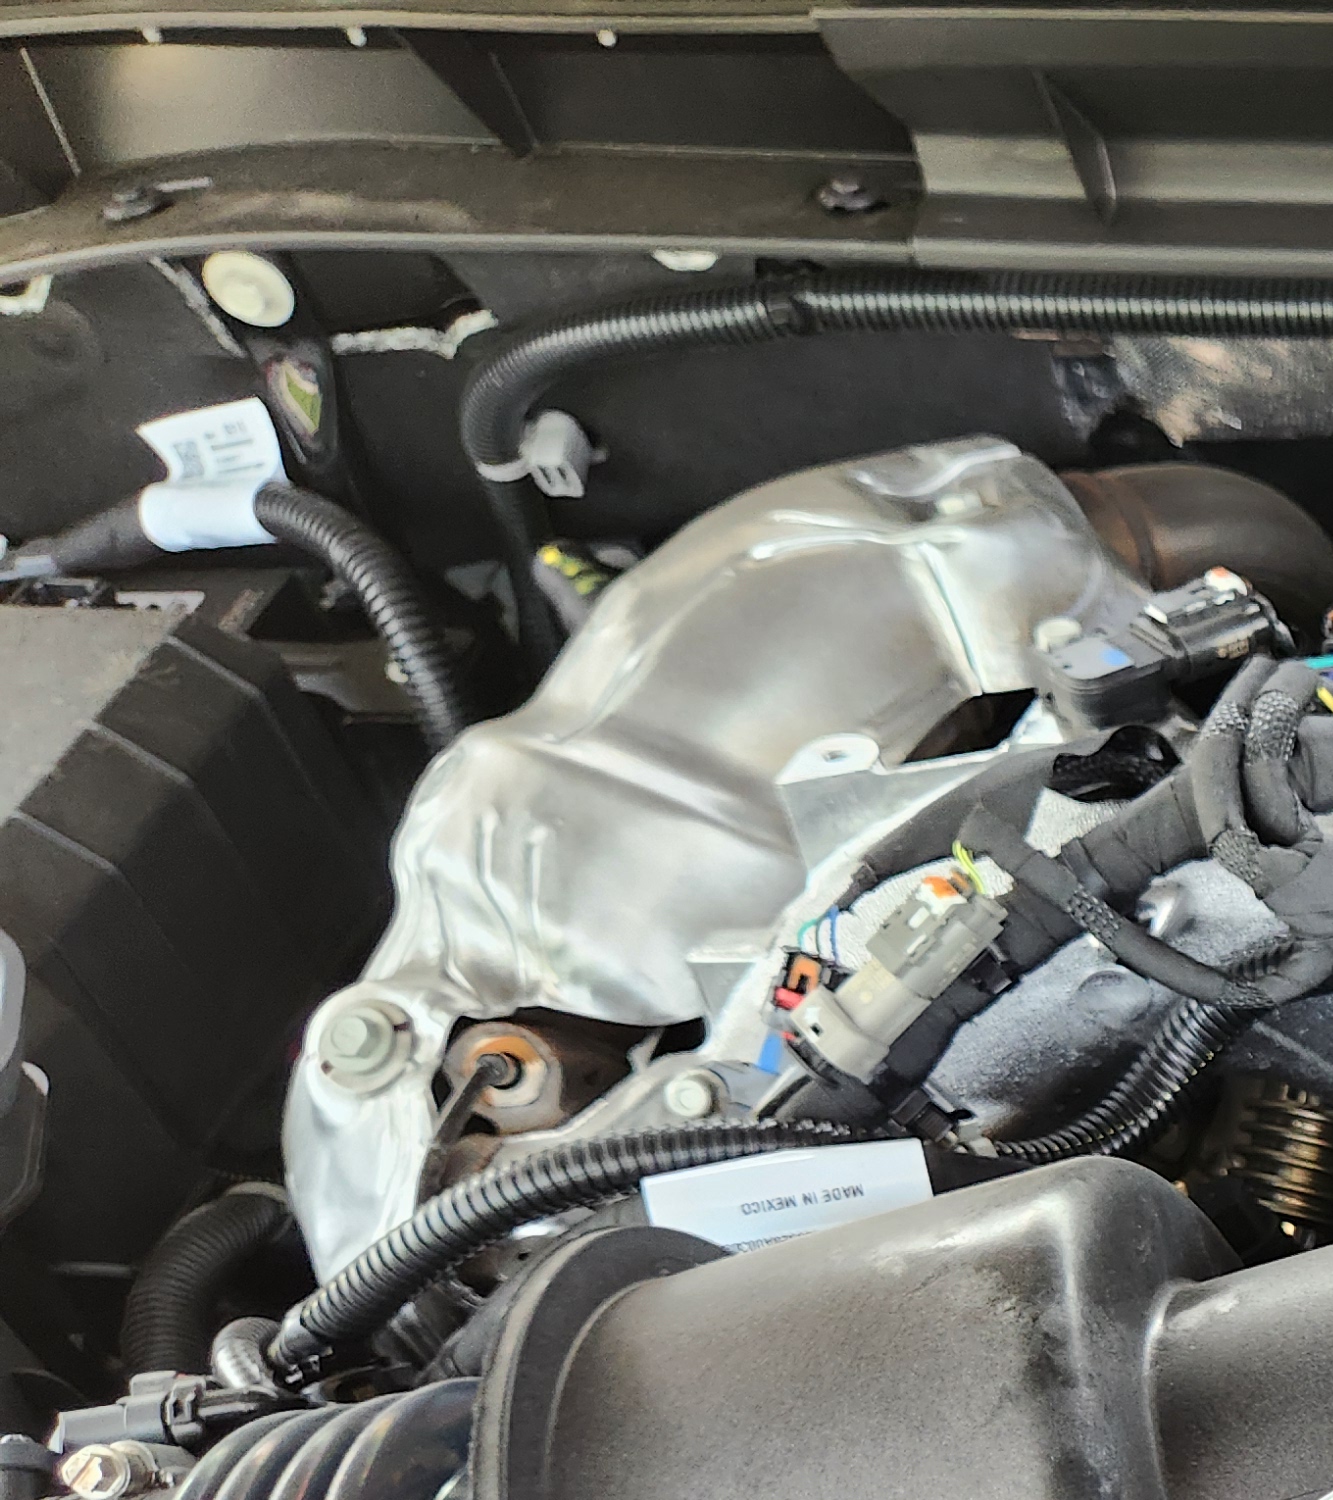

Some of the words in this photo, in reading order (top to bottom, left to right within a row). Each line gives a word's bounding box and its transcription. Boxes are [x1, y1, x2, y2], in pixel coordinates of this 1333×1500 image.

[801, 1191, 818, 1206] IN
[821, 1183, 864, 1203] MADE
[740, 1195, 798, 1215] MEXICO
